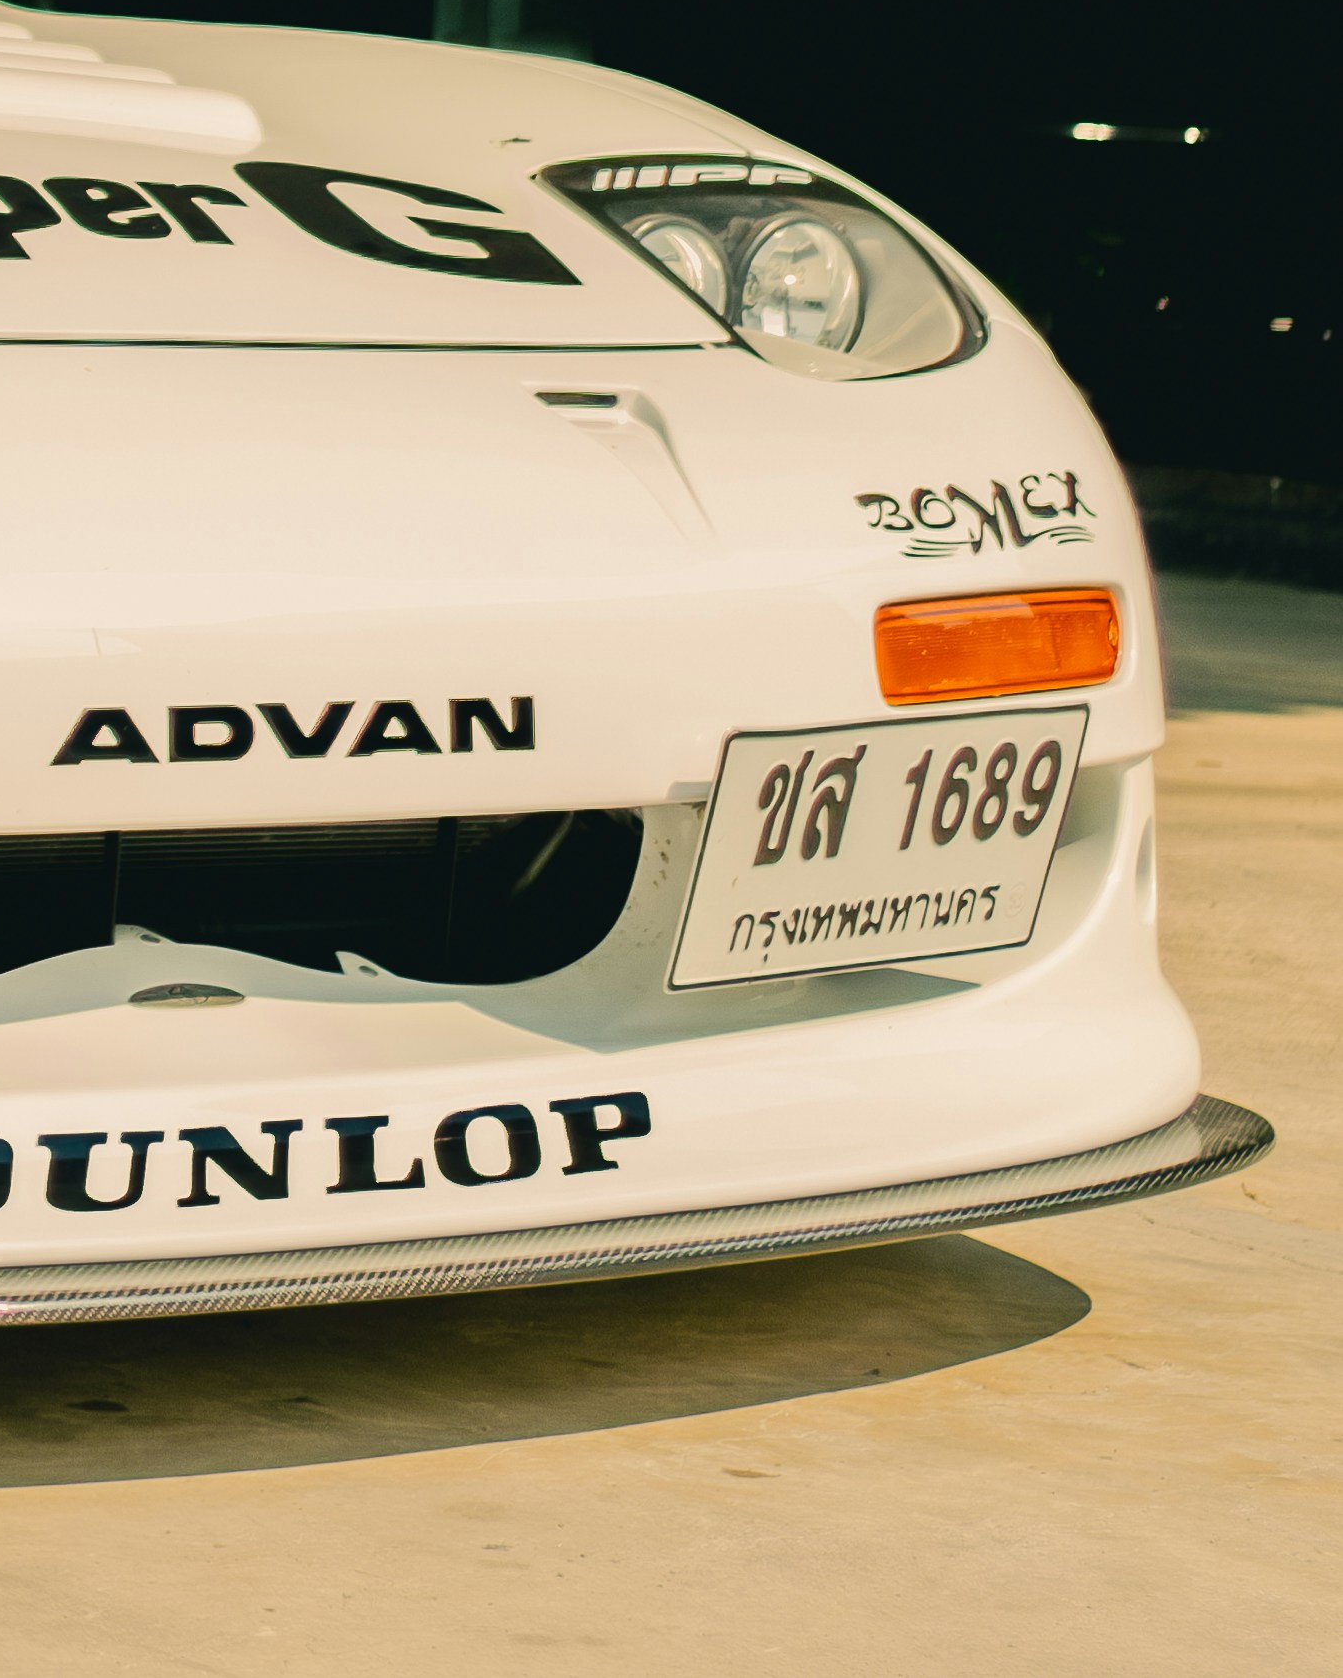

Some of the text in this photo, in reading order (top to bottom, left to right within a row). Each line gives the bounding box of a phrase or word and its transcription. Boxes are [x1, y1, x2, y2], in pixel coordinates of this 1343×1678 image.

[48, 694, 537, 766] ADVAN
[898, 739, 1063, 851] 1689
[729, 884, 1001, 963] กรุงเทพมหานคร
